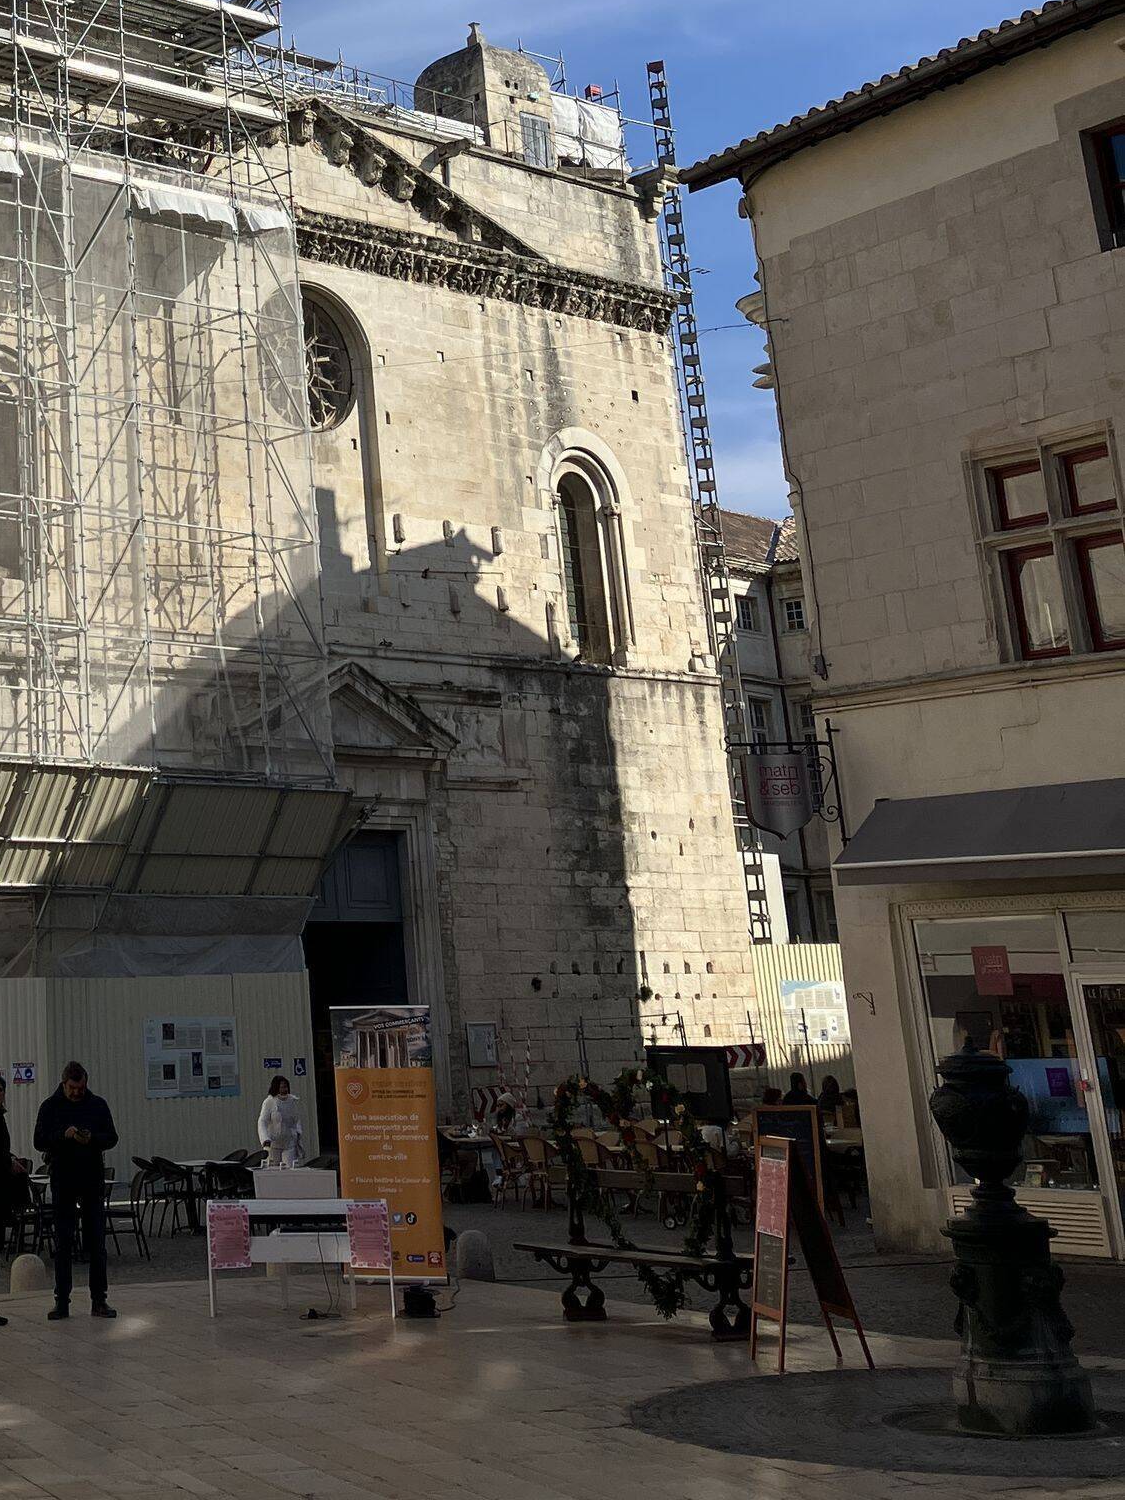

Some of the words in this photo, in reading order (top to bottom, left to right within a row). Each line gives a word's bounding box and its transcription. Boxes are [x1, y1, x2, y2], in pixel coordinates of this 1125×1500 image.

[772, 779, 801, 796] seb
[352, 1113, 367, 1121] Une
[368, 1113, 408, 1121] association
[409, 1112, 419, 1121] de
[402, 1124, 419, 1132] pour
[344, 1133, 382, 1142] dynamiser
[382, 1142, 393, 1151] du
[368, 1153, 408, 1161] centre-ville
